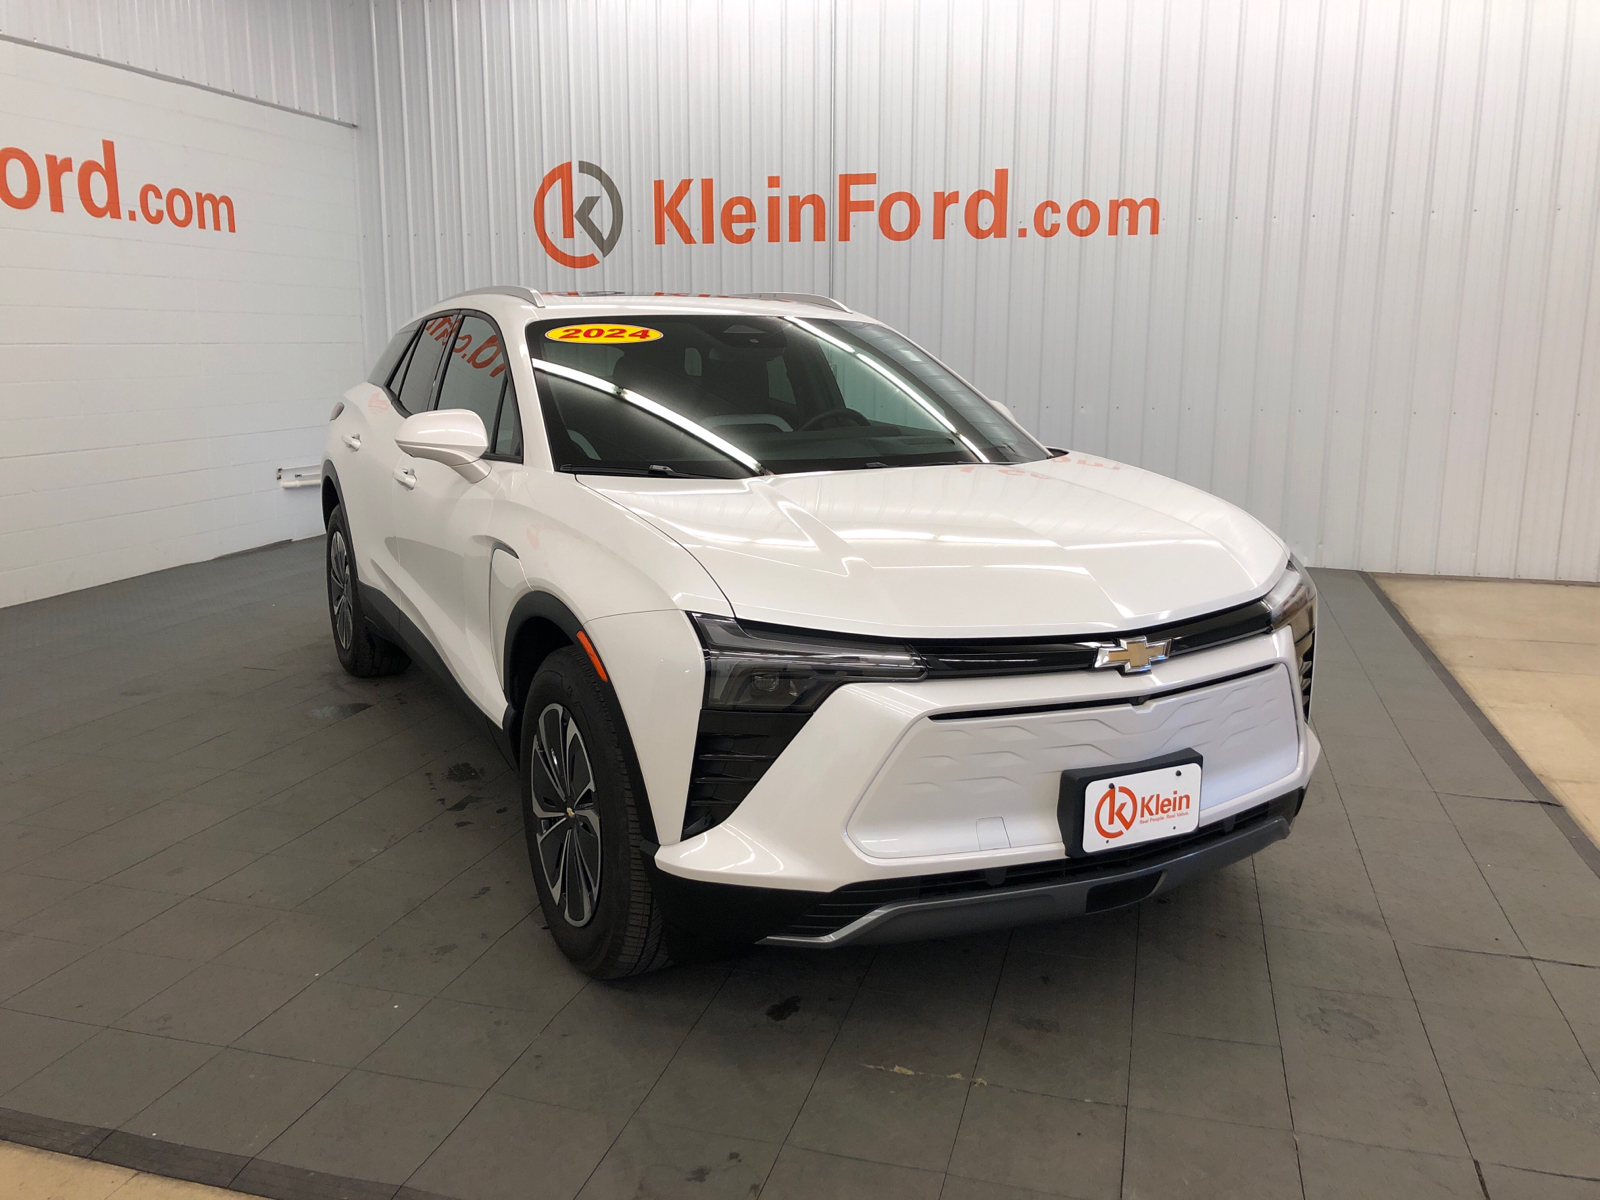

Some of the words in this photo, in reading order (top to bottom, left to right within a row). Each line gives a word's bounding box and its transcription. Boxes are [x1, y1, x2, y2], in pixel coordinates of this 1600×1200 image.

[653, 168, 1160, 246] KleinFord.com
[558, 328, 650, 339] 2024
[1140, 790, 1190, 818] Klein
